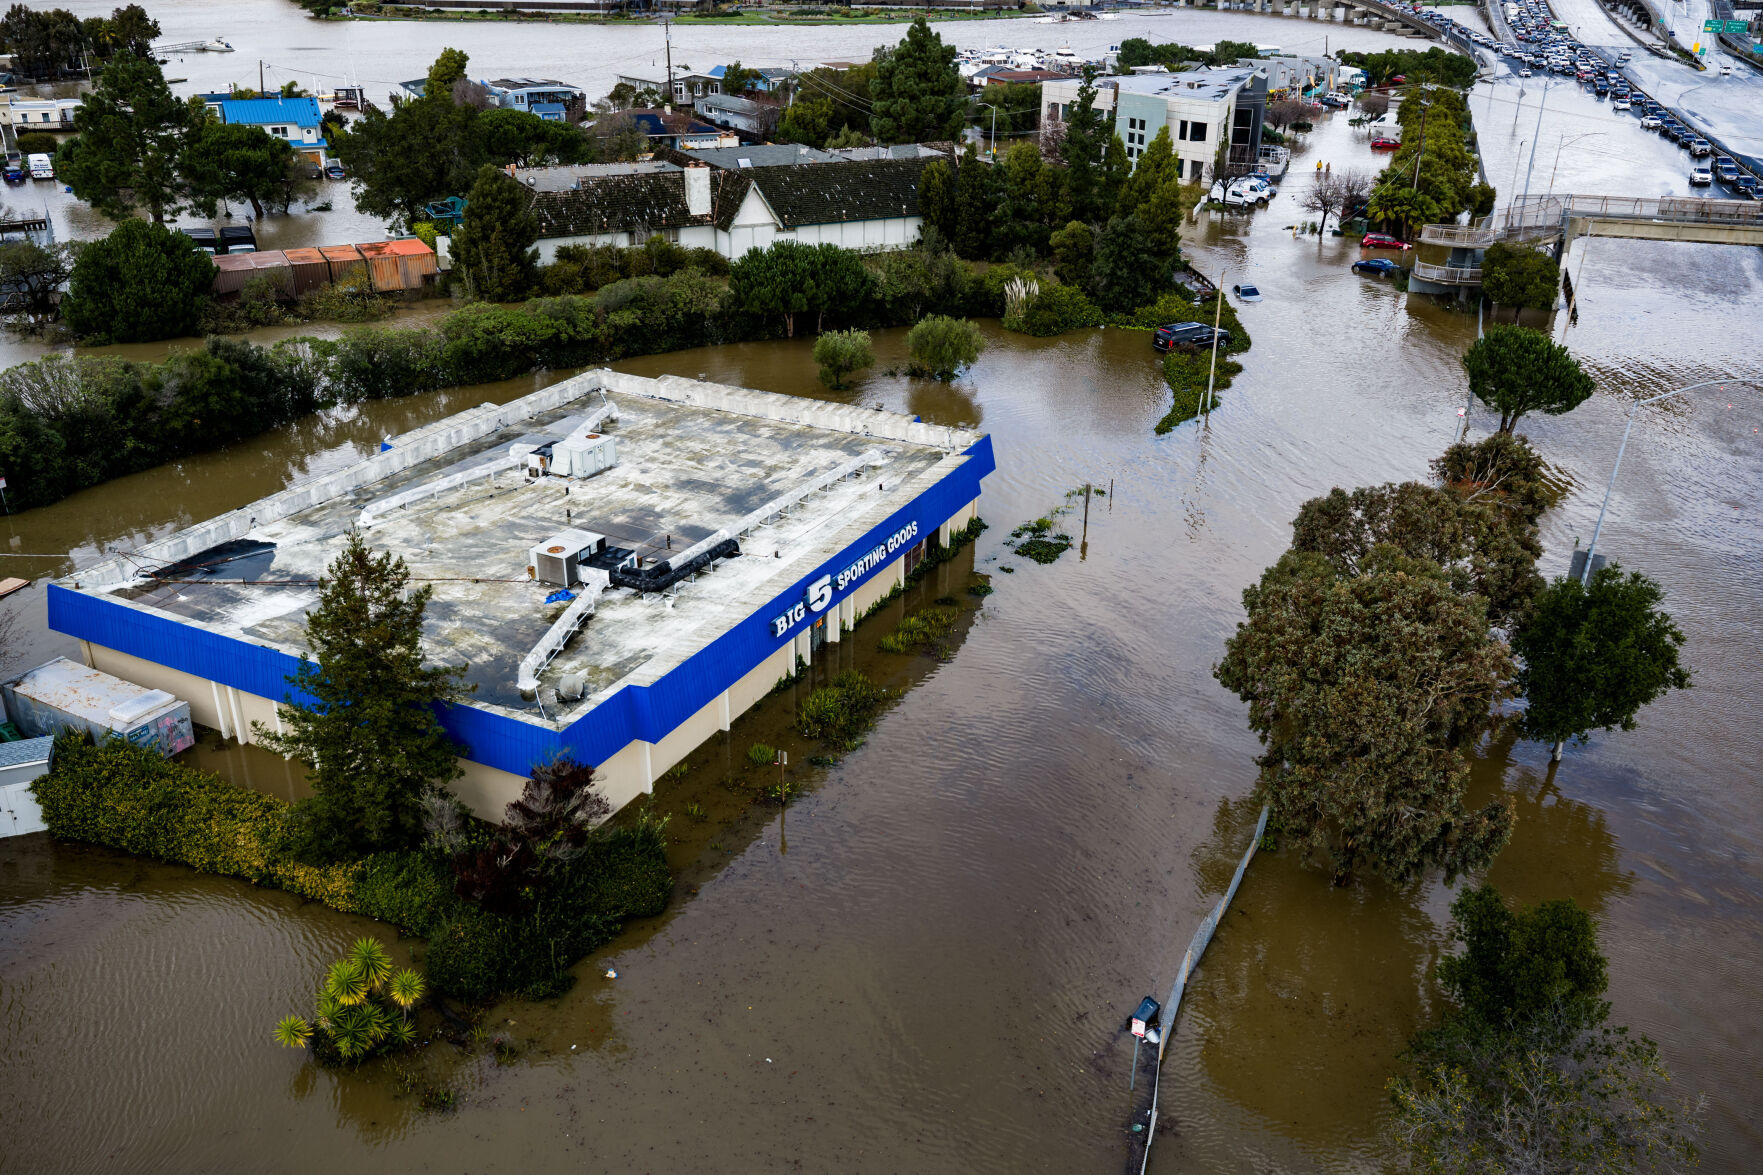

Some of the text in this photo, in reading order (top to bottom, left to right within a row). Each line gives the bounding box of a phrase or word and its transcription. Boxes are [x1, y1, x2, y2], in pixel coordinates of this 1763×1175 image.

[775, 521, 918, 638] BIG 5 SPORTING GOODS
